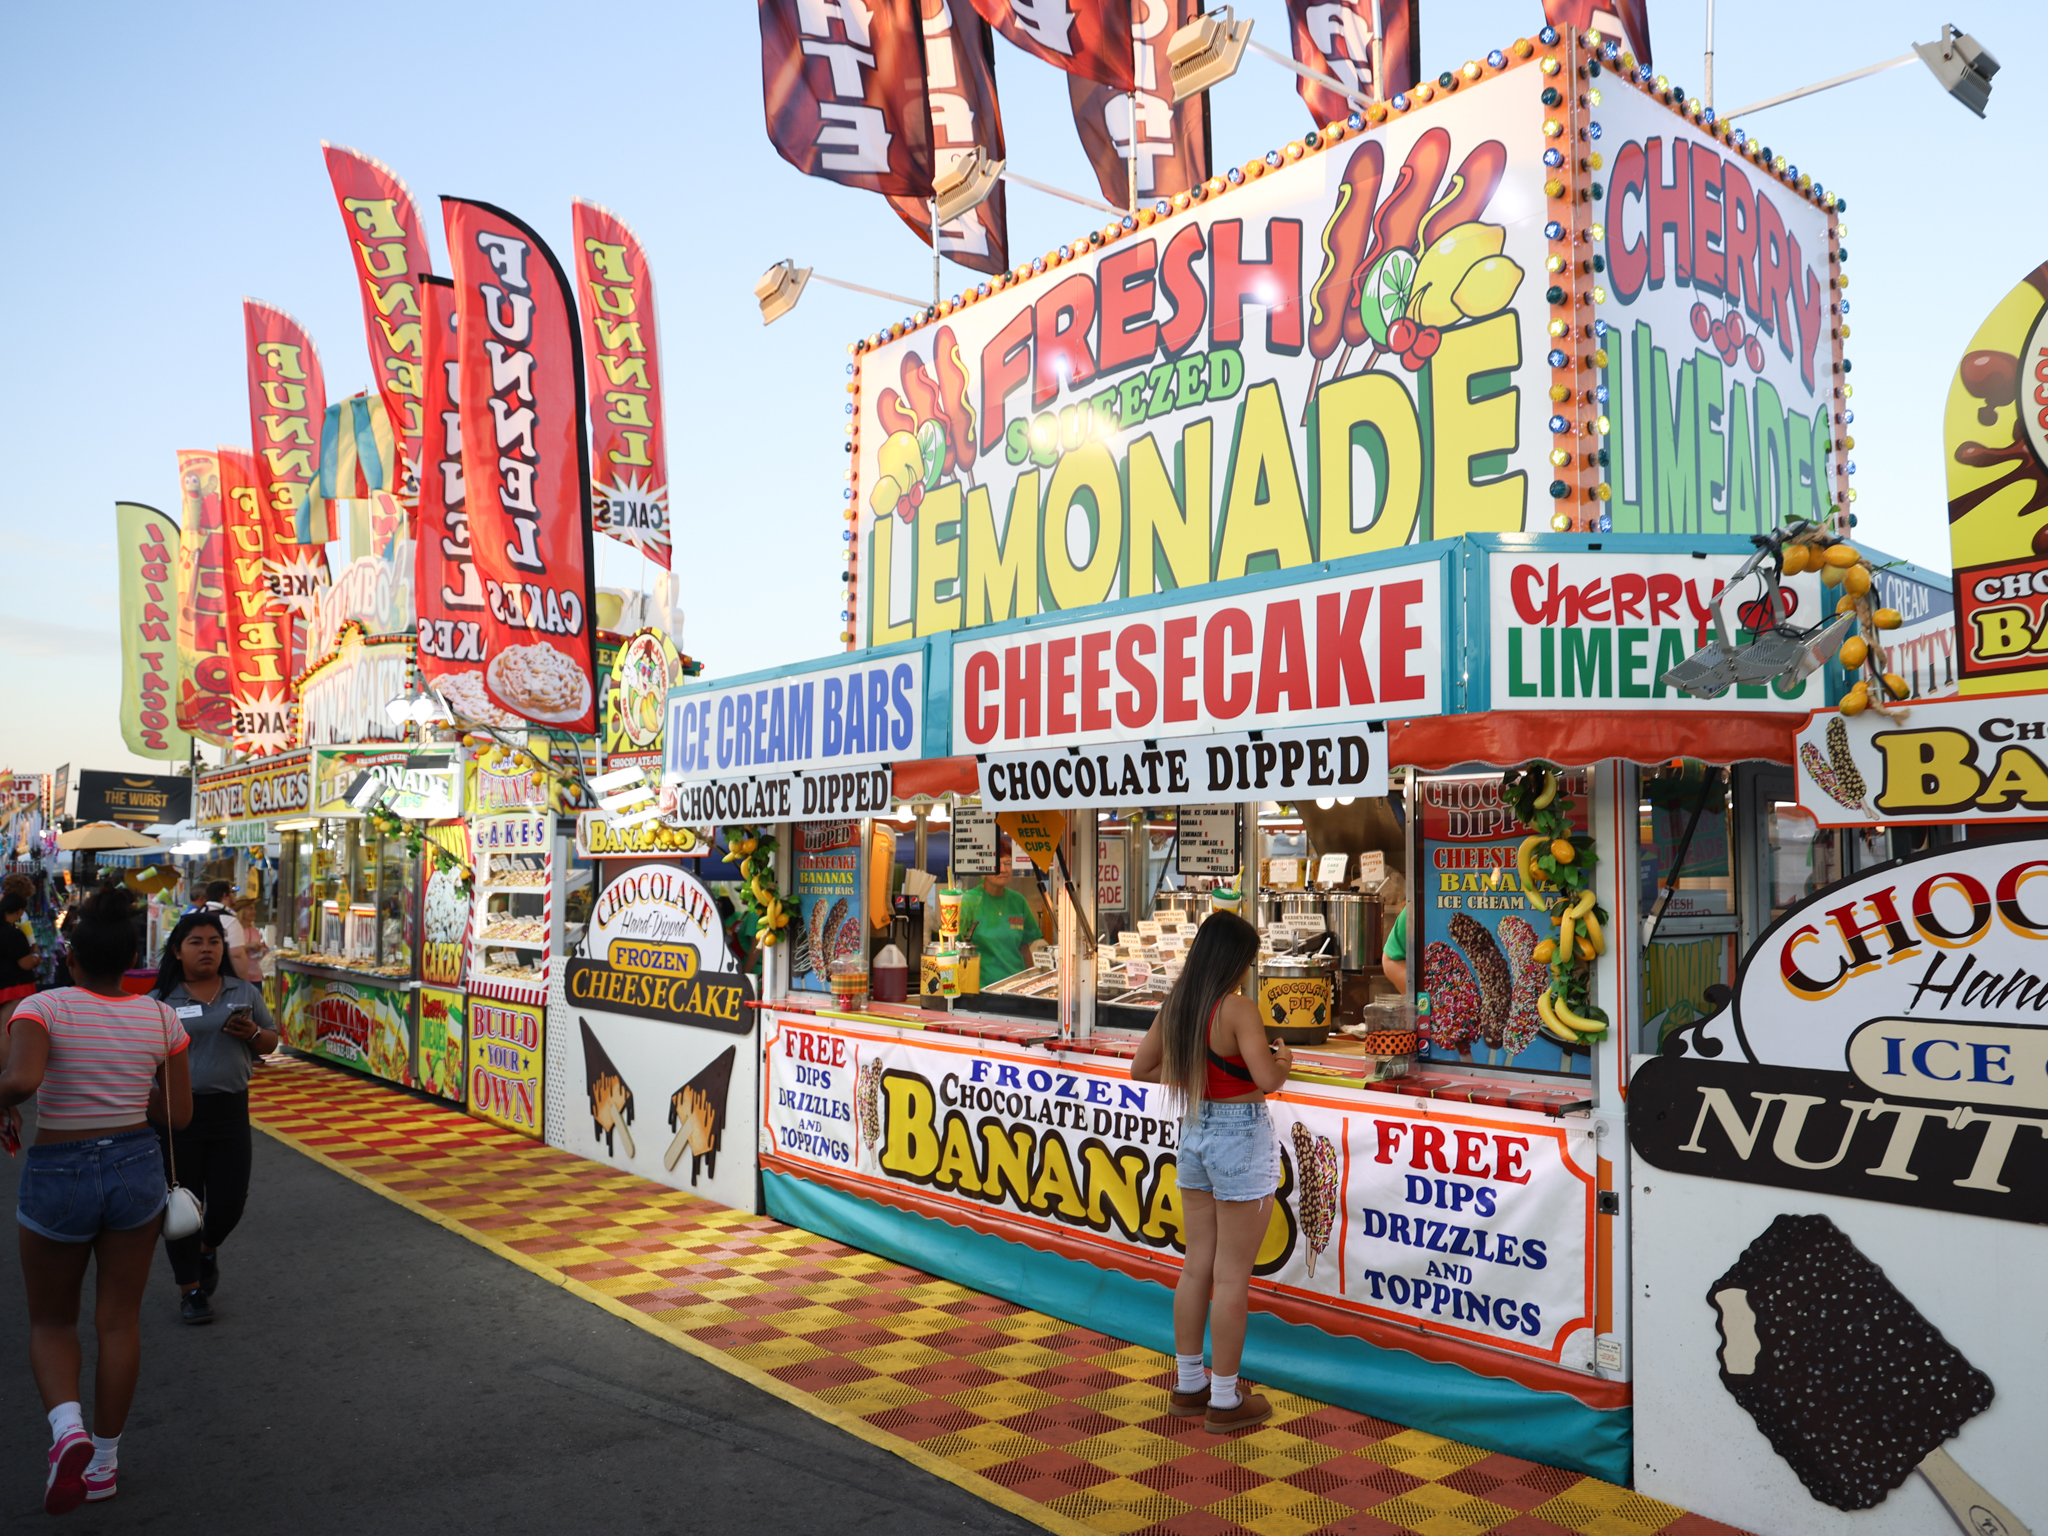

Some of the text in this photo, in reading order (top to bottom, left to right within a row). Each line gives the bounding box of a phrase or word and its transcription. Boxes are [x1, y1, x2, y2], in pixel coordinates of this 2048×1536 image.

[1605, 136, 1822, 397] CHERRY
[979, 217, 1304, 457] FRESH
[1005, 349, 1245, 467] SQUEEZED
[869, 307, 1528, 648] LEMONADE
[962, 578, 1426, 746] CHEESECAKE
[1508, 626, 1808, 699] LIMEA
[670, 662, 915, 773] ICE CREAM BARS
[478, 768, 547, 808] FUNNEL
[987, 735, 1371, 802] CHOCOLATE DIPPED
[104, 790, 169, 808] THE WURST
[199, 770, 309, 824] FUNNEL CAKES
[679, 773, 792, 823] CHOCOLATE
[801, 769, 890, 813] DIPPED
[804, 826, 850, 850] DIPPED
[1017, 828, 1050, 838] REFILL
[1021, 813, 1039, 824] ALL
[797, 855, 857, 870] CHEESECAKE
[1024, 841, 1052, 852] CUPS
[798, 885, 854, 895] ICE CREAM BARS
[799, 871, 854, 885] BANANAS
[596, 872, 714, 938] CHOCOLATE
[1437, 895, 1462, 909] ICE
[1467, 895, 1525, 910] CREAM
[1667, 898, 1694, 910] RESH
[620, 910, 689, 942] Hand-Dipped
[422, 941, 464, 985] CAKES
[614, 946, 689, 973] FROZEN
[571, 967, 743, 1022] CHEESECAKE
[1267, 982, 1328, 1001] CHOCOLATE
[1289, 996, 1316, 1011] DIP
[315, 997, 369, 1058] LEMONADE
[472, 1003, 539, 1052] BUILD
[784, 1029, 847, 1068] FREE
[486, 1042, 520, 1074] YOUR
[796, 1065, 832, 1089] DIPS
[1881, 1037, 2015, 1086] ICE
[473, 1065, 537, 1128] OWN
[778, 1086, 852, 1122] DRIZZLES
[970, 1059, 1150, 1112] FROZEN
[798, 1119, 823, 1133] AND
[940, 1072, 1183, 1150] CHOCOLATE DIPPE
[780, 1126, 850, 1163] TOPPINGS
[1373, 1119, 1532, 1187] FREE
[1404, 1174, 1498, 1218] DIPS
[1362, 1208, 1548, 1271] DRIZZLES
[1425, 1260, 1473, 1286] AND
[1364, 1269, 1542, 1337] TOPPINGS
